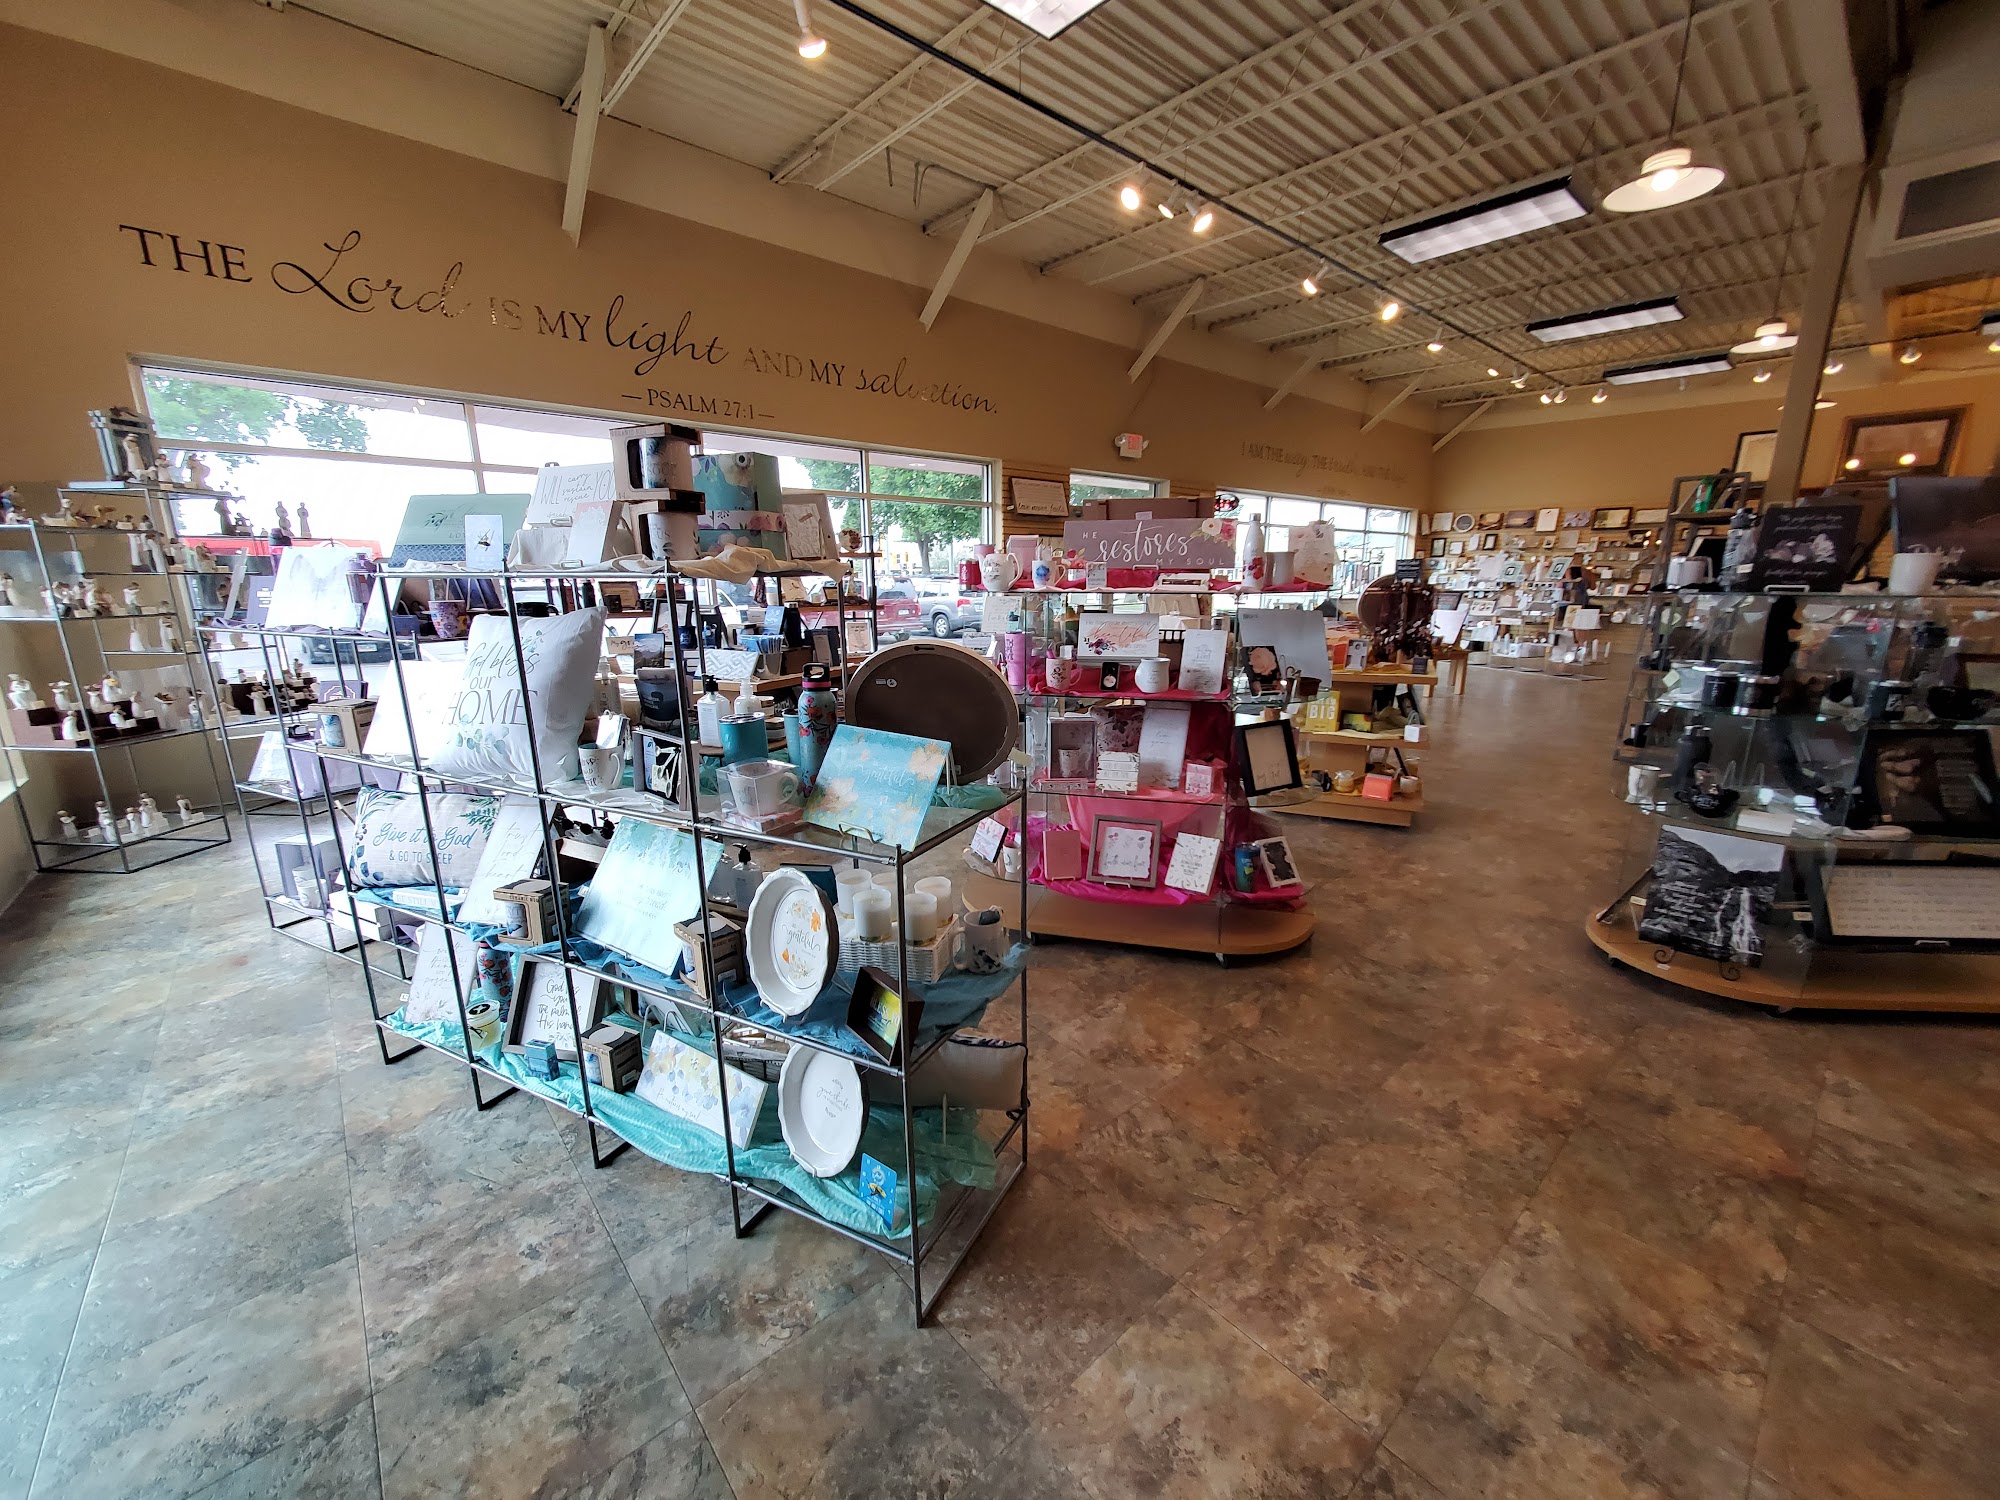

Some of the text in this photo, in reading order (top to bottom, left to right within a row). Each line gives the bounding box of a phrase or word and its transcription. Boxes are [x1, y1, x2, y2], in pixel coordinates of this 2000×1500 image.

[119, 224, 253, 283] THE
[270, 230, 472, 318] Lord
[487, 296, 524, 331] IS
[534, 305, 592, 343] MY
[605, 294, 729, 377] light
[743, 346, 802, 380] AND
[809, 358, 846, 388] MY
[646, 388, 755, 420] PSALM 27:1
[1082, 531, 1098, 540] HE
[1093, 520, 1198, 563] restores
[1155, 557, 1226, 566] MY SOUL
[469, 675, 497, 690] our
[441, 688, 539, 727] HOME
[1308, 704, 1336, 720] BIG
[372, 822, 408, 847] Give
[437, 825, 479, 851] God
[388, 849, 454, 865] & GO TO SEEP
[781, 923, 822, 952] grateful
[546, 978, 565, 994] God
